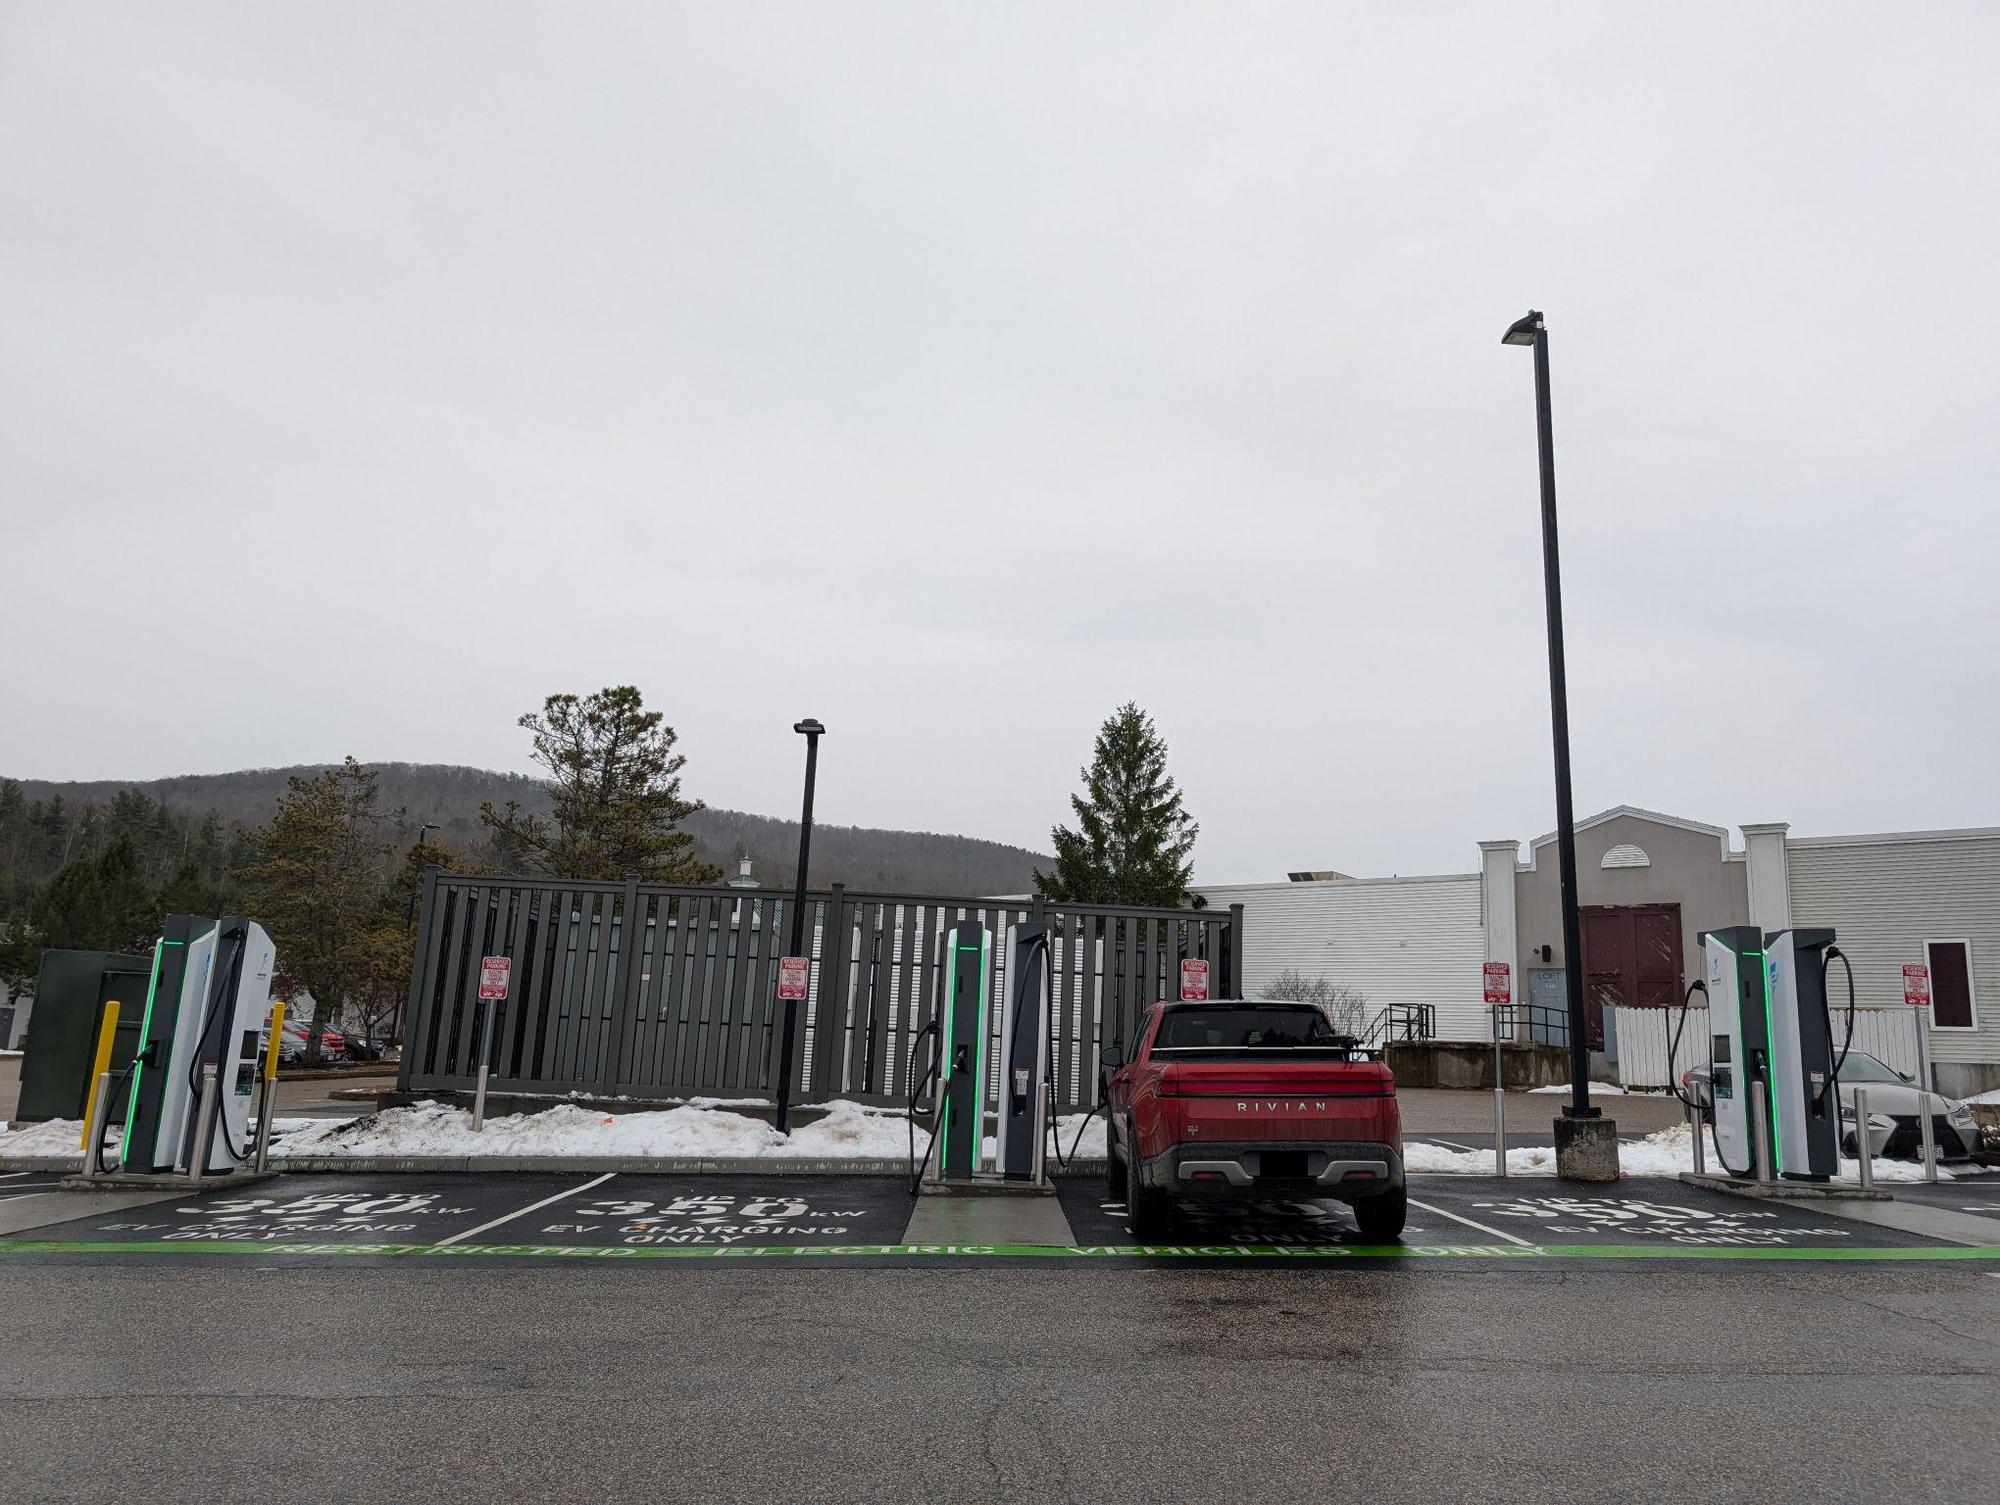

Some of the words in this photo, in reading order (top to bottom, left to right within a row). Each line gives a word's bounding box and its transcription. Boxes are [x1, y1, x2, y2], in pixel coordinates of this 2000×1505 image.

[1537, 972, 1561, 980] LOFT
[1237, 1102, 1326, 1112] RIVIAN
[175, 1199, 433, 1215] 350
[575, 1200, 810, 1217] 350
[1471, 1203, 1716, 1219] 350
[97, 1223, 172, 1231] EV
[177, 1223, 417, 1232] CHARGING
[541, 1224, 603, 1233] EV
[617, 1225, 848, 1235] CHARGING
[1618, 1227, 1850, 1236] CHARGING
[161, 1232, 296, 1240] ONLY
[623, 1235, 746, 1244] ONLY
[1670, 1236, 1792, 1244] ONLY
[261, 1243, 637, 1256] RESTRICTED
[712, 1246, 995, 1256] ELECTRIC
[1065, 1246, 1353, 1256] VEHICLES
[1411, 1246, 1548, 1255] ONLY
